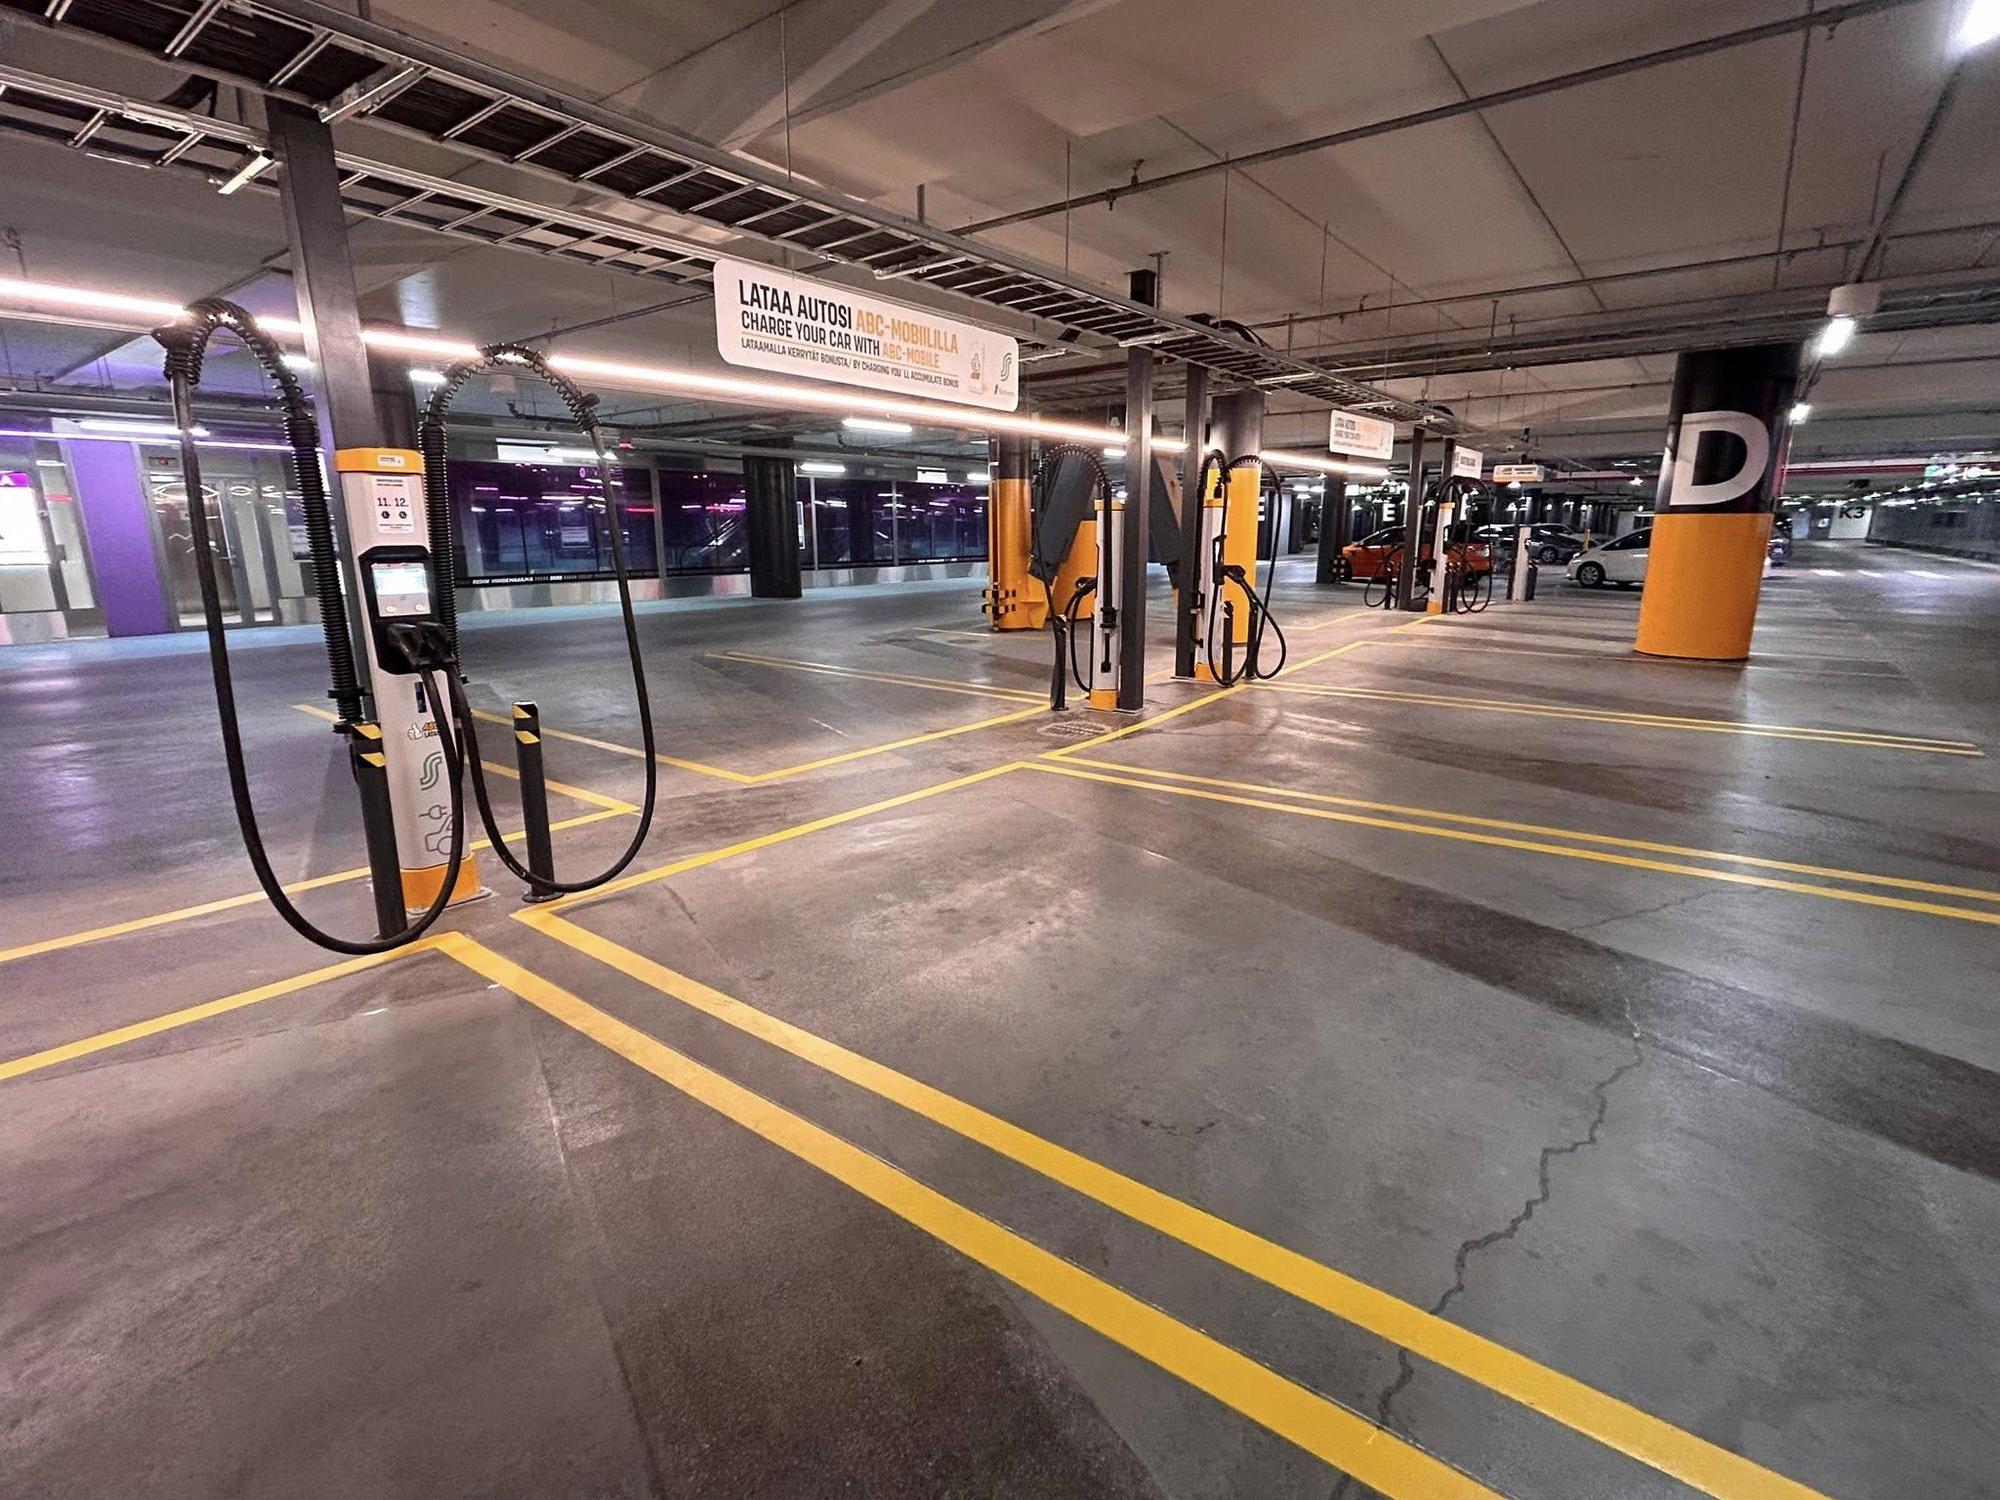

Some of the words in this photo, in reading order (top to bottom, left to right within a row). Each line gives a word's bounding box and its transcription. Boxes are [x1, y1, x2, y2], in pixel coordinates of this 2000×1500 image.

[739, 279, 793, 316] LATAA
[798, 294, 852, 329] AUTOSI
[741, 310, 792, 338] CHARGE
[795, 322, 826, 345] YOUR
[830, 330, 852, 351] CAR
[854, 335, 880, 356] WITH
[883, 342, 940, 368] ABC-MOBILE
[741, 338, 786, 355] LATAAMALLA
[1669, 410, 1770, 505] D
[1382, 503, 1396, 521] E
[1839, 506, 1866, 519] K3
